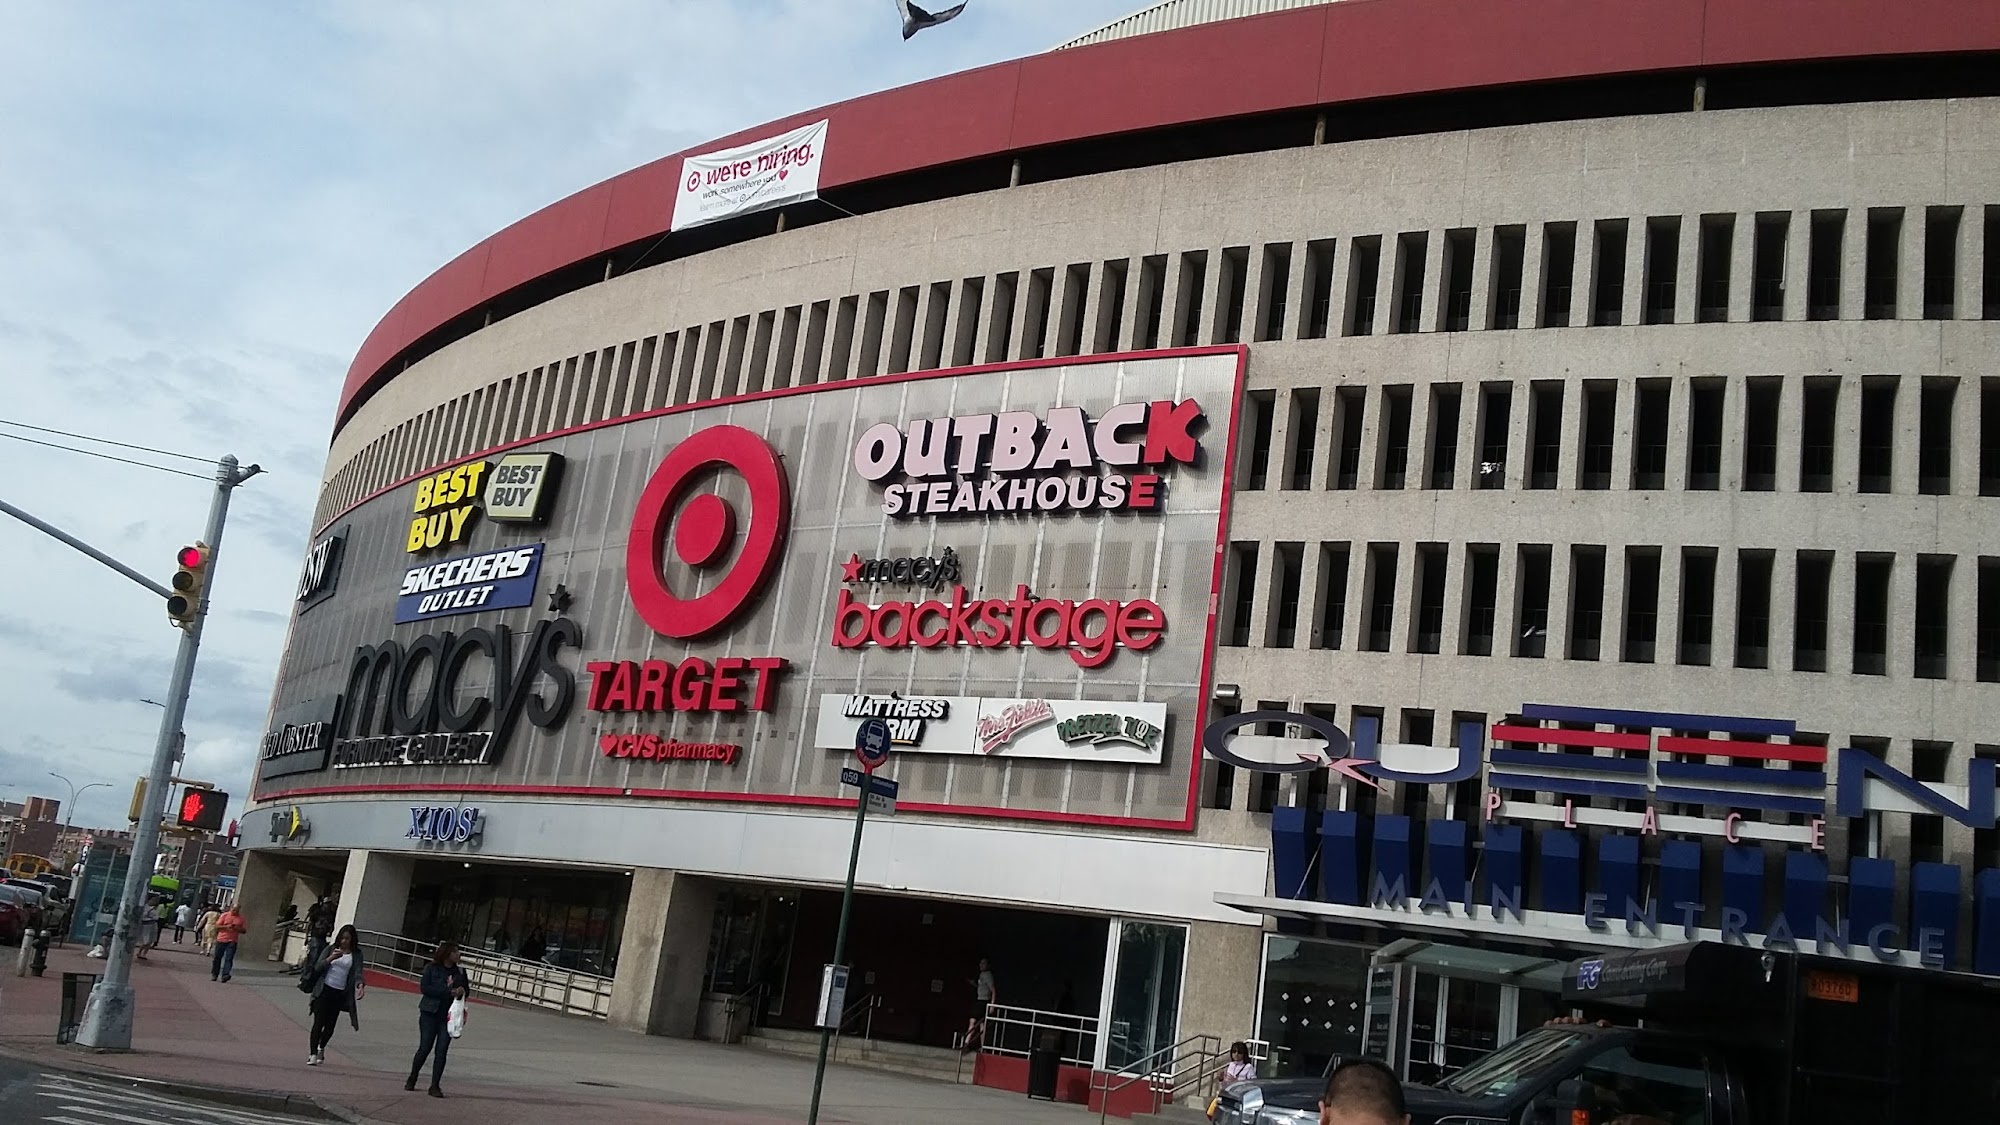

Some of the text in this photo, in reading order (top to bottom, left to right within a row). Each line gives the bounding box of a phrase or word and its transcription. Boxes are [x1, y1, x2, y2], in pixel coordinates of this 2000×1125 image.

[706, 159, 751, 185] we're
[702, 188, 719, 199] work
[720, 179, 762, 195] somewhere
[854, 398, 1203, 481] OUTBACK
[413, 461, 487, 513] BEST
[496, 465, 543, 485] BEST
[491, 487, 534, 507] BUY
[881, 473, 1160, 515] STEAKHOUSE
[407, 505, 475, 553] BUY
[399, 548, 534, 596] SKECHERS
[418, 585, 494, 614] OUTLET
[832, 584, 1167, 668] backstage
[586, 656, 786, 712] TARGET
[841, 695, 948, 718] MATTRESS
[277, 721, 322, 756] LOBSTER
[1057, 713, 1122, 742] PRETZEL
[334, 732, 487, 764] FURNITURE GALLERY
[617, 734, 738, 764] CVS pharmacy
[842, 771, 859, 784] Q59
[404, 806, 477, 842] XIOS
[1485, 793, 1827, 851] PLACE
[1371, 870, 1947, 966] MAIN ENTRANCE
[1602, 961, 1647, 984] Contracting
[1646, 957, 1668, 980] Corp.
